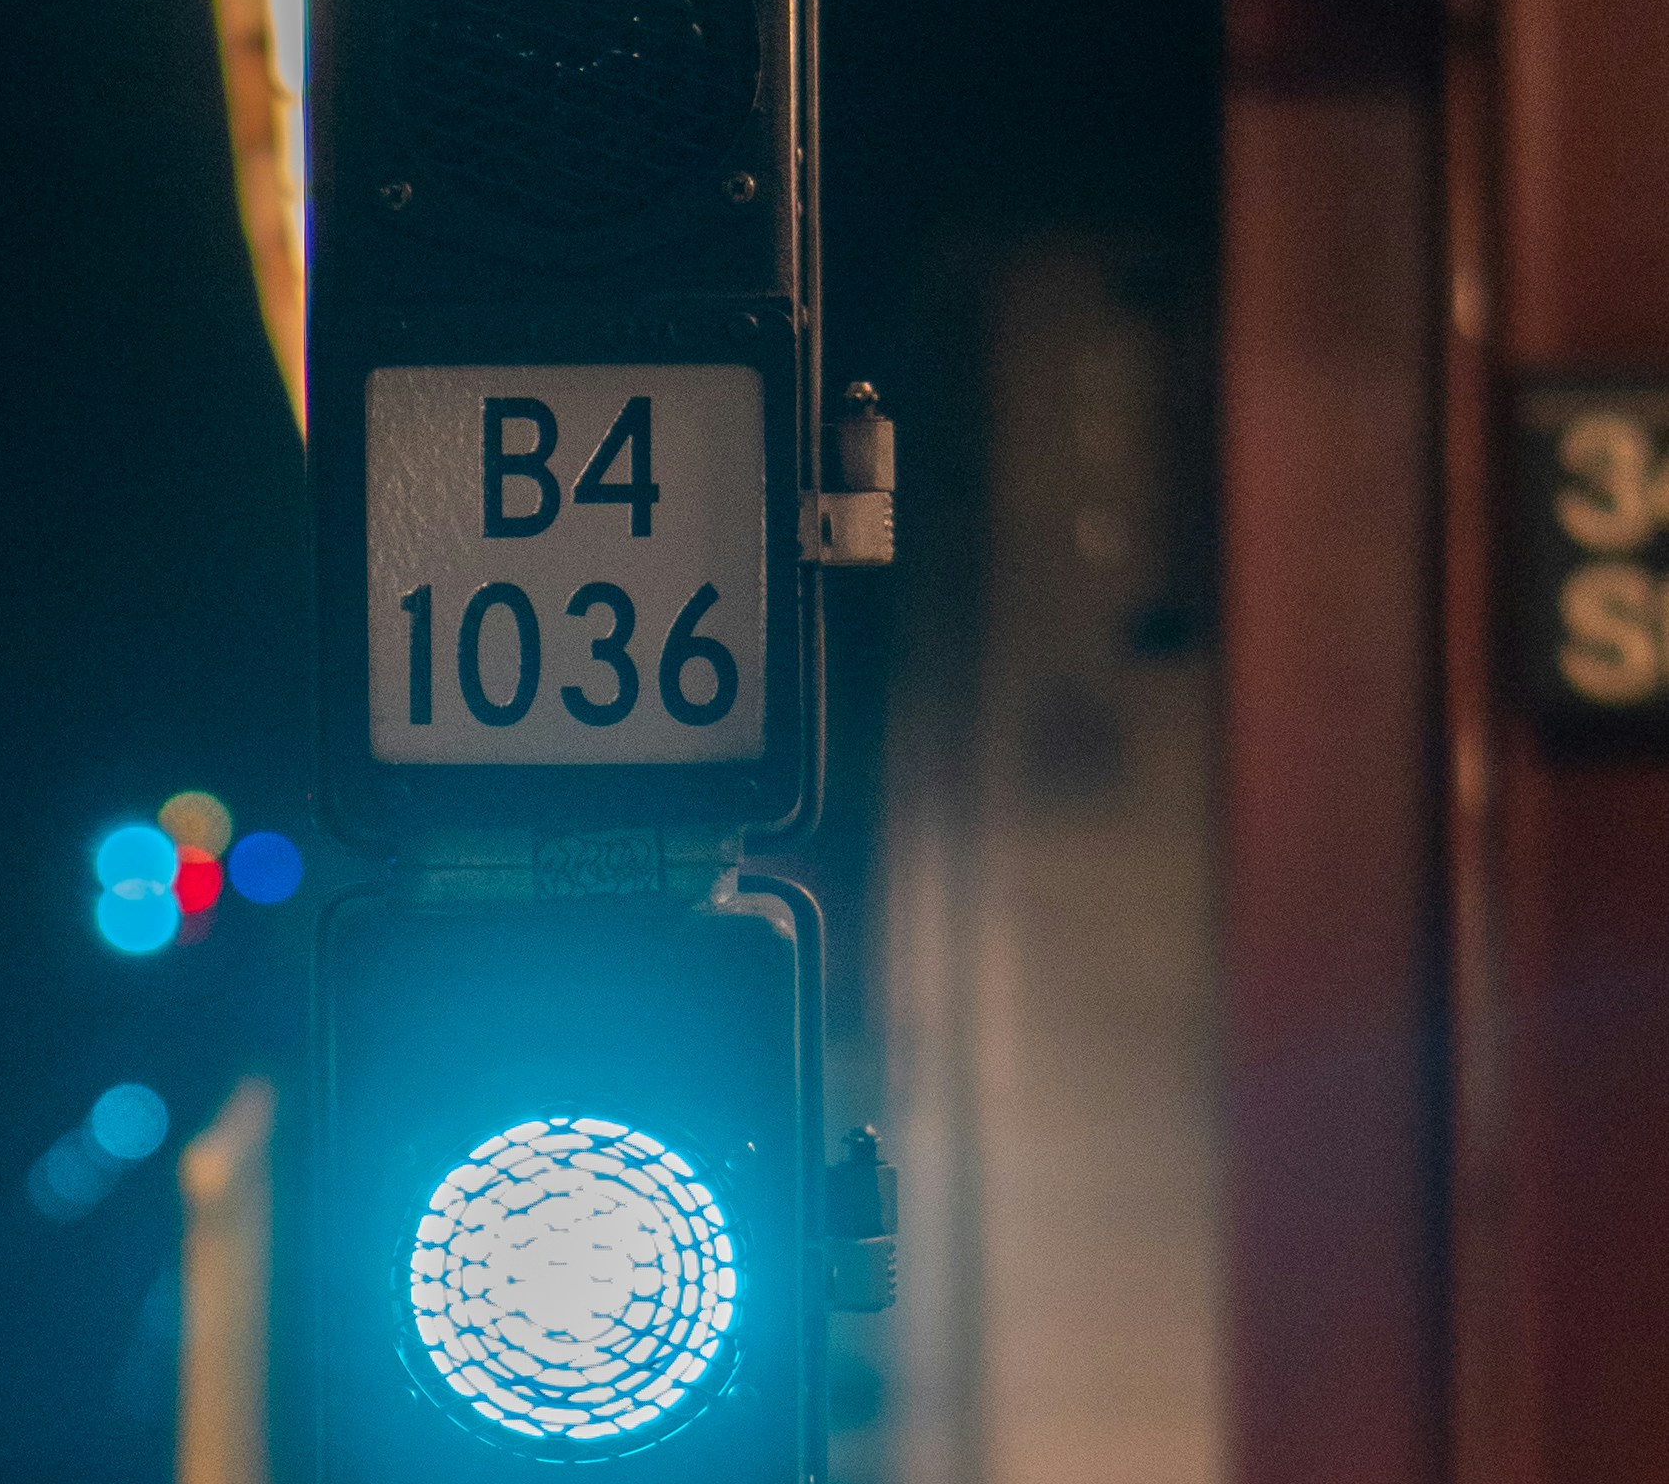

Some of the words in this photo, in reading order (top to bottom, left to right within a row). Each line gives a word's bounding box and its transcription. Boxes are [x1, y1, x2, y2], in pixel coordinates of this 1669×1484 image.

[482, 396, 660, 538] B4
[400, 581, 739, 728] 1036
[1558, 564, 1669, 705] S
